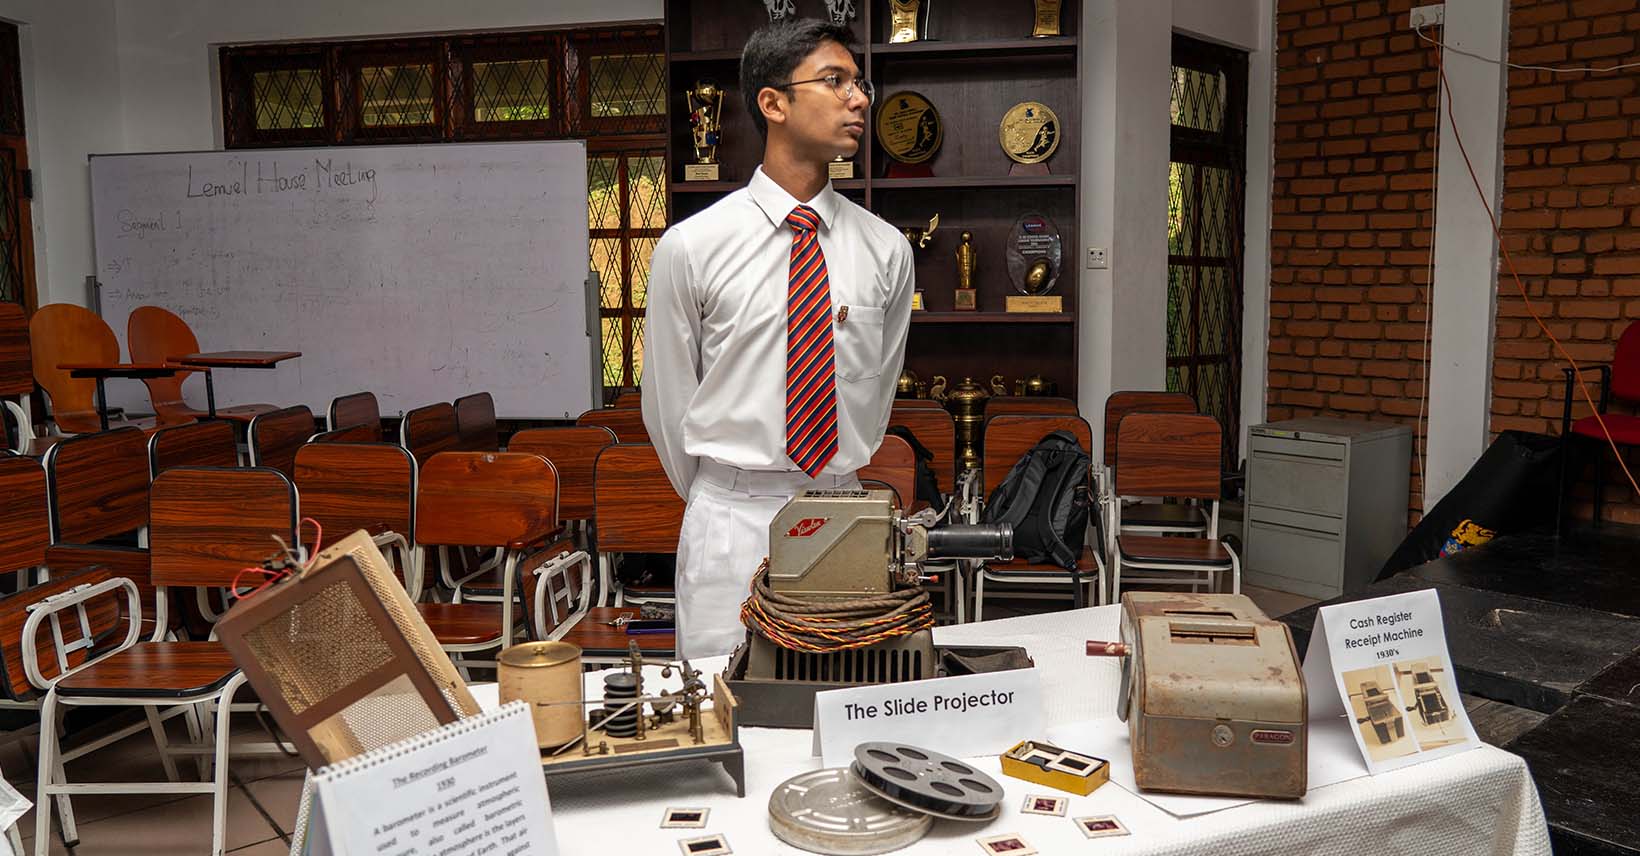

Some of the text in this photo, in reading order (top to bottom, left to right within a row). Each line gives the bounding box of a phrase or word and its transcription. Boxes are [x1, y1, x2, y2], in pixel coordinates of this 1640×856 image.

[256, 160, 306, 194] House
[315, 157, 377, 201] Meeting
[117, 207, 168, 240] Segment
[1344, 628, 1424, 649] Receipt Machine
[1349, 612, 1413, 630] Cash Register
[1376, 648, 1400, 660] 1930's
[845, 690, 1015, 721] The Slide Projector
[392, 745, 488, 789] The Recording Barometer
[373, 826, 381, 836] A
[382, 810, 426, 833] barometer
[444, 788, 476, 808] scientific
[479, 771, 518, 792] instrument
[377, 837, 398, 852] used
[410, 828, 420, 838] to
[433, 810, 465, 828] measure
[477, 785, 521, 809] atmospheric
[429, 799, 523, 847] also called barometric
[439, 833, 483, 856] atmosphere
[491, 823, 504, 834] the
[505, 813, 526, 828] layers
[501, 831, 517, 845] That
[519, 827, 529, 837] air
